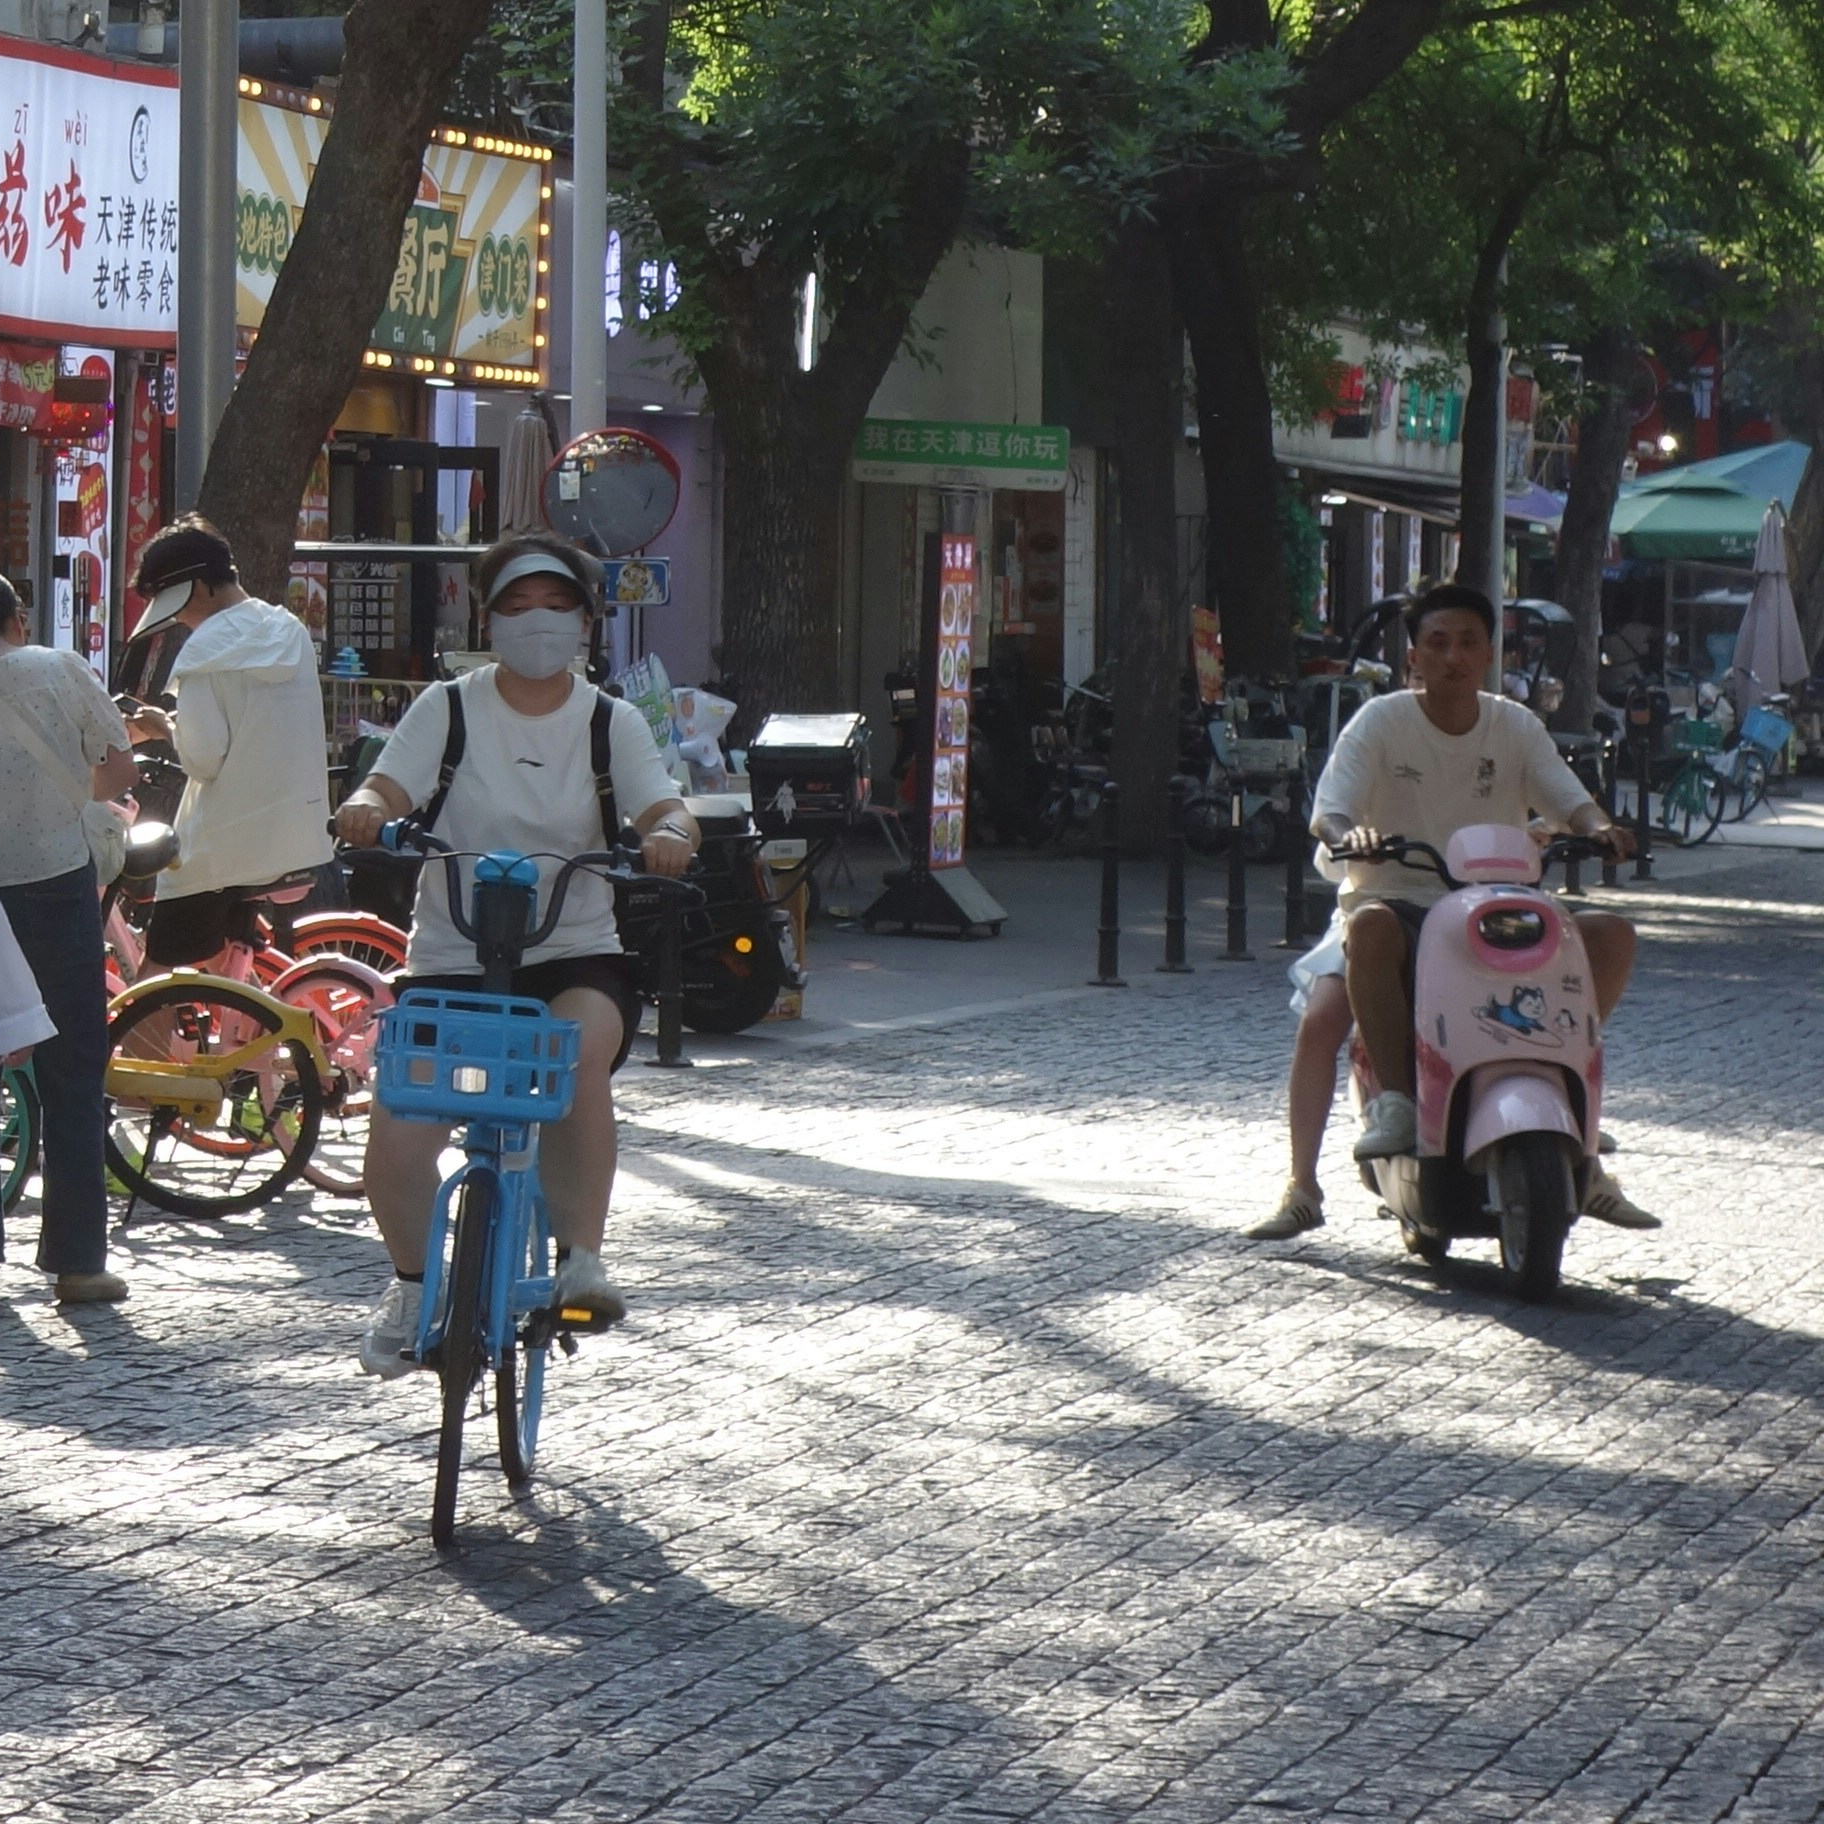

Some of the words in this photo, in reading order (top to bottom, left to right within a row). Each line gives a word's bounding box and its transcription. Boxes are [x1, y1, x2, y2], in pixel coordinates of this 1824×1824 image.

[94, 194, 178, 255] 天津传统
[90, 255, 175, 315] 老味零食
[478, 249, 529, 305] 津门菜
[864, 425, 1061, 461] 我在天津逗你玩
